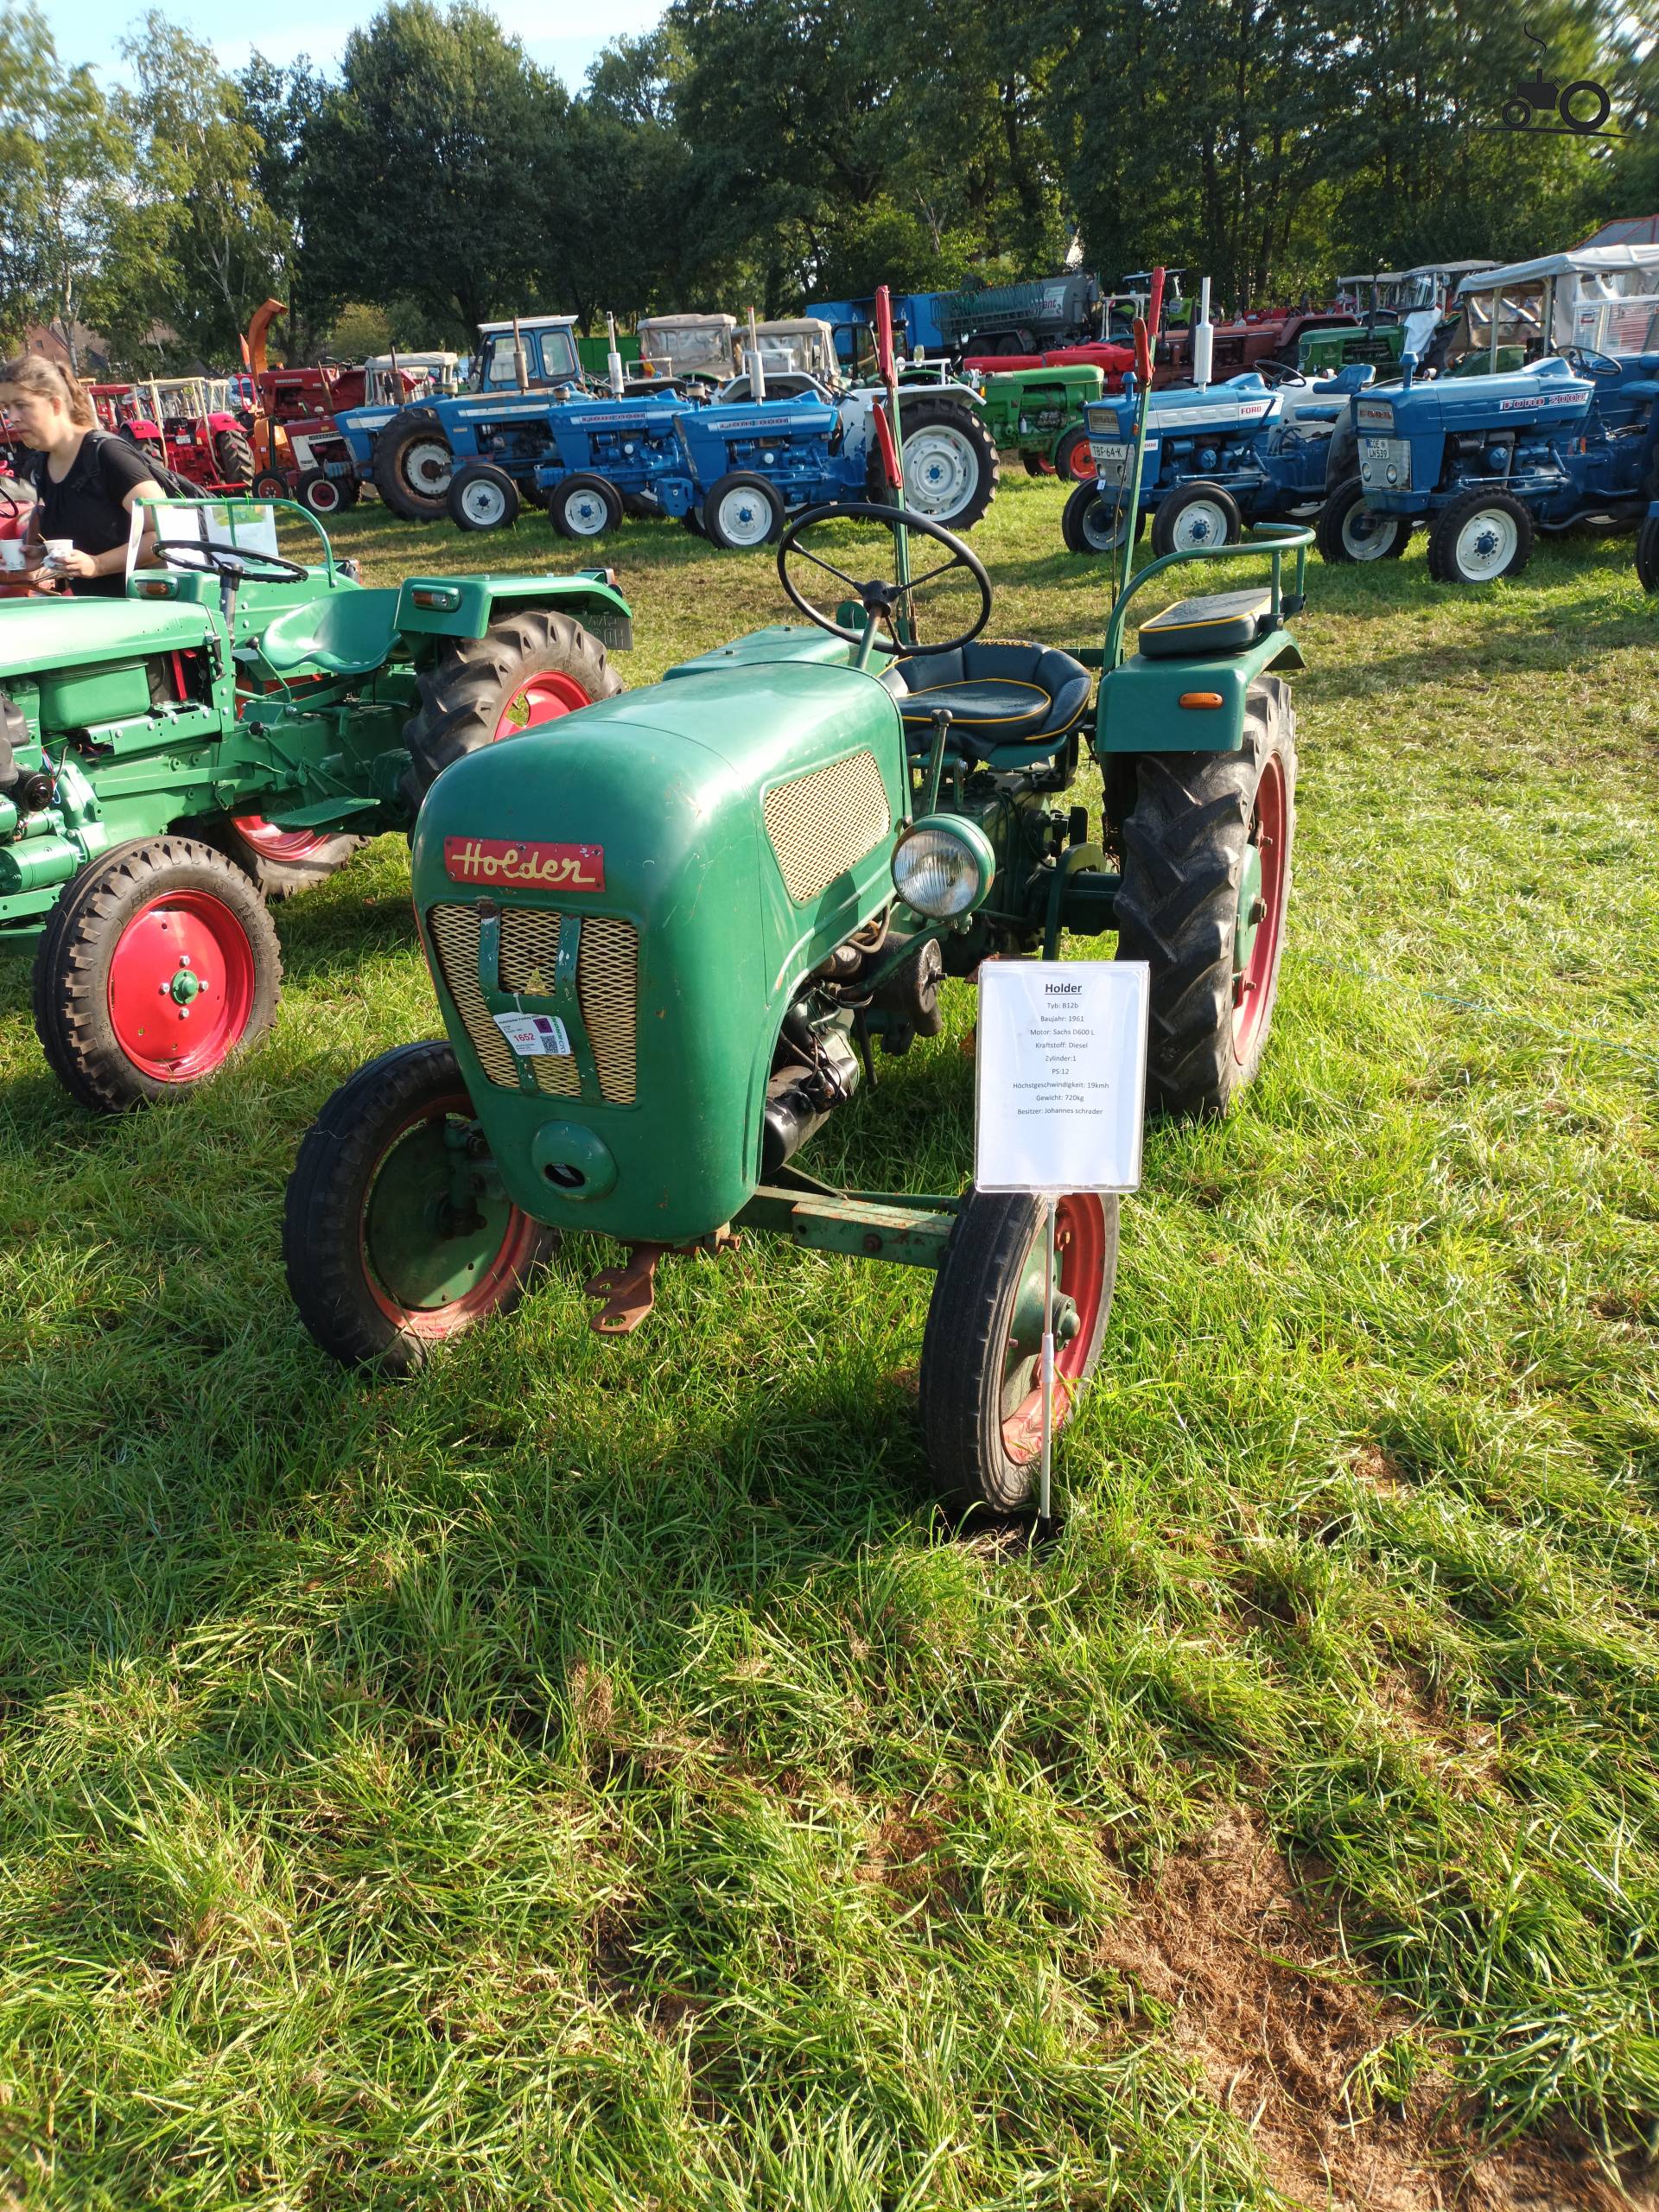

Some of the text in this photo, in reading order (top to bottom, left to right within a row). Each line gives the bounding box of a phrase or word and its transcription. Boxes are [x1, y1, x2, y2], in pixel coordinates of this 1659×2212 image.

[1504, 392, 1586, 410] FORD 2000
[1241, 406, 1262, 415] FORD
[452, 842, 596, 884] Holder
[1045, 983, 1083, 995] Holder
[512, 1033, 536, 1042] 1652
